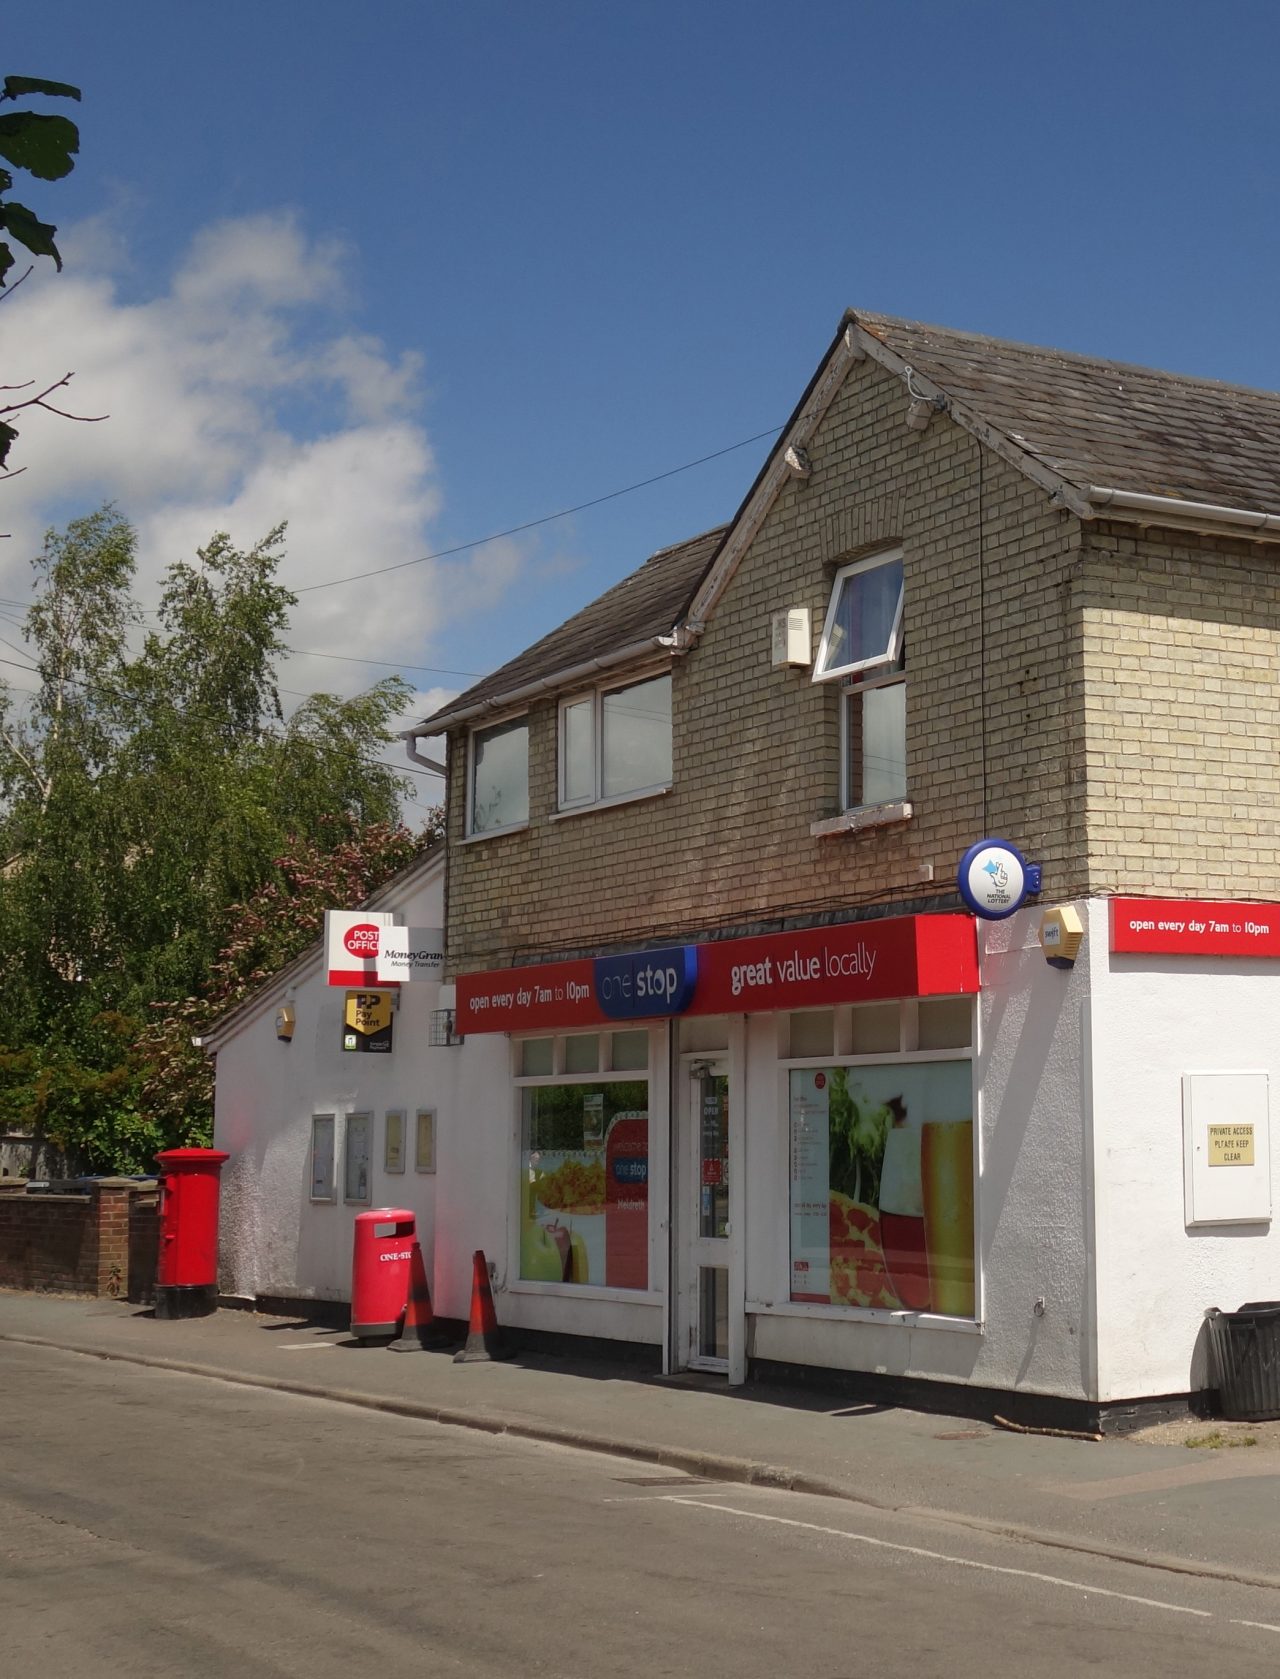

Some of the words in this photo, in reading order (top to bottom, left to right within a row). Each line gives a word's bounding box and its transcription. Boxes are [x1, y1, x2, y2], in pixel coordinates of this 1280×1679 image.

[1129, 920, 1155, 934] open
[1158, 921, 1185, 934] every
[1188, 920, 1206, 934] day
[1209, 920, 1229, 933] 7am
[1232, 922, 1242, 933] to
[1244, 922, 1270, 937] 10pm
[353, 930, 379, 941] POST
[347, 940, 379, 950] OFFIC
[391, 960, 413, 969] Money
[414, 960, 440, 968] Transfer
[731, 956, 772, 996] great
[777, 950, 820, 983] value
[824, 942, 877, 981] locally
[602, 973, 633, 1000] one
[636, 965, 678, 1004] stop
[469, 994, 489, 1014] open
[491, 991, 514, 1009] every
[516, 988, 532, 1008] day
[534, 985, 552, 1004] 7am
[554, 986, 564, 1001] to
[566, 981, 590, 1003] 10pm
[355, 1010, 373, 1019] Pay
[355, 1018, 381, 1027] Point
[1210, 1127, 1231, 1136] PRIVATE
[1233, 1127, 1253, 1135] ACCESS
[1236, 1139, 1249, 1148] KEEP
[1224, 1152, 1241, 1161] CLEAR
[630, 1161, 647, 1180] stop
